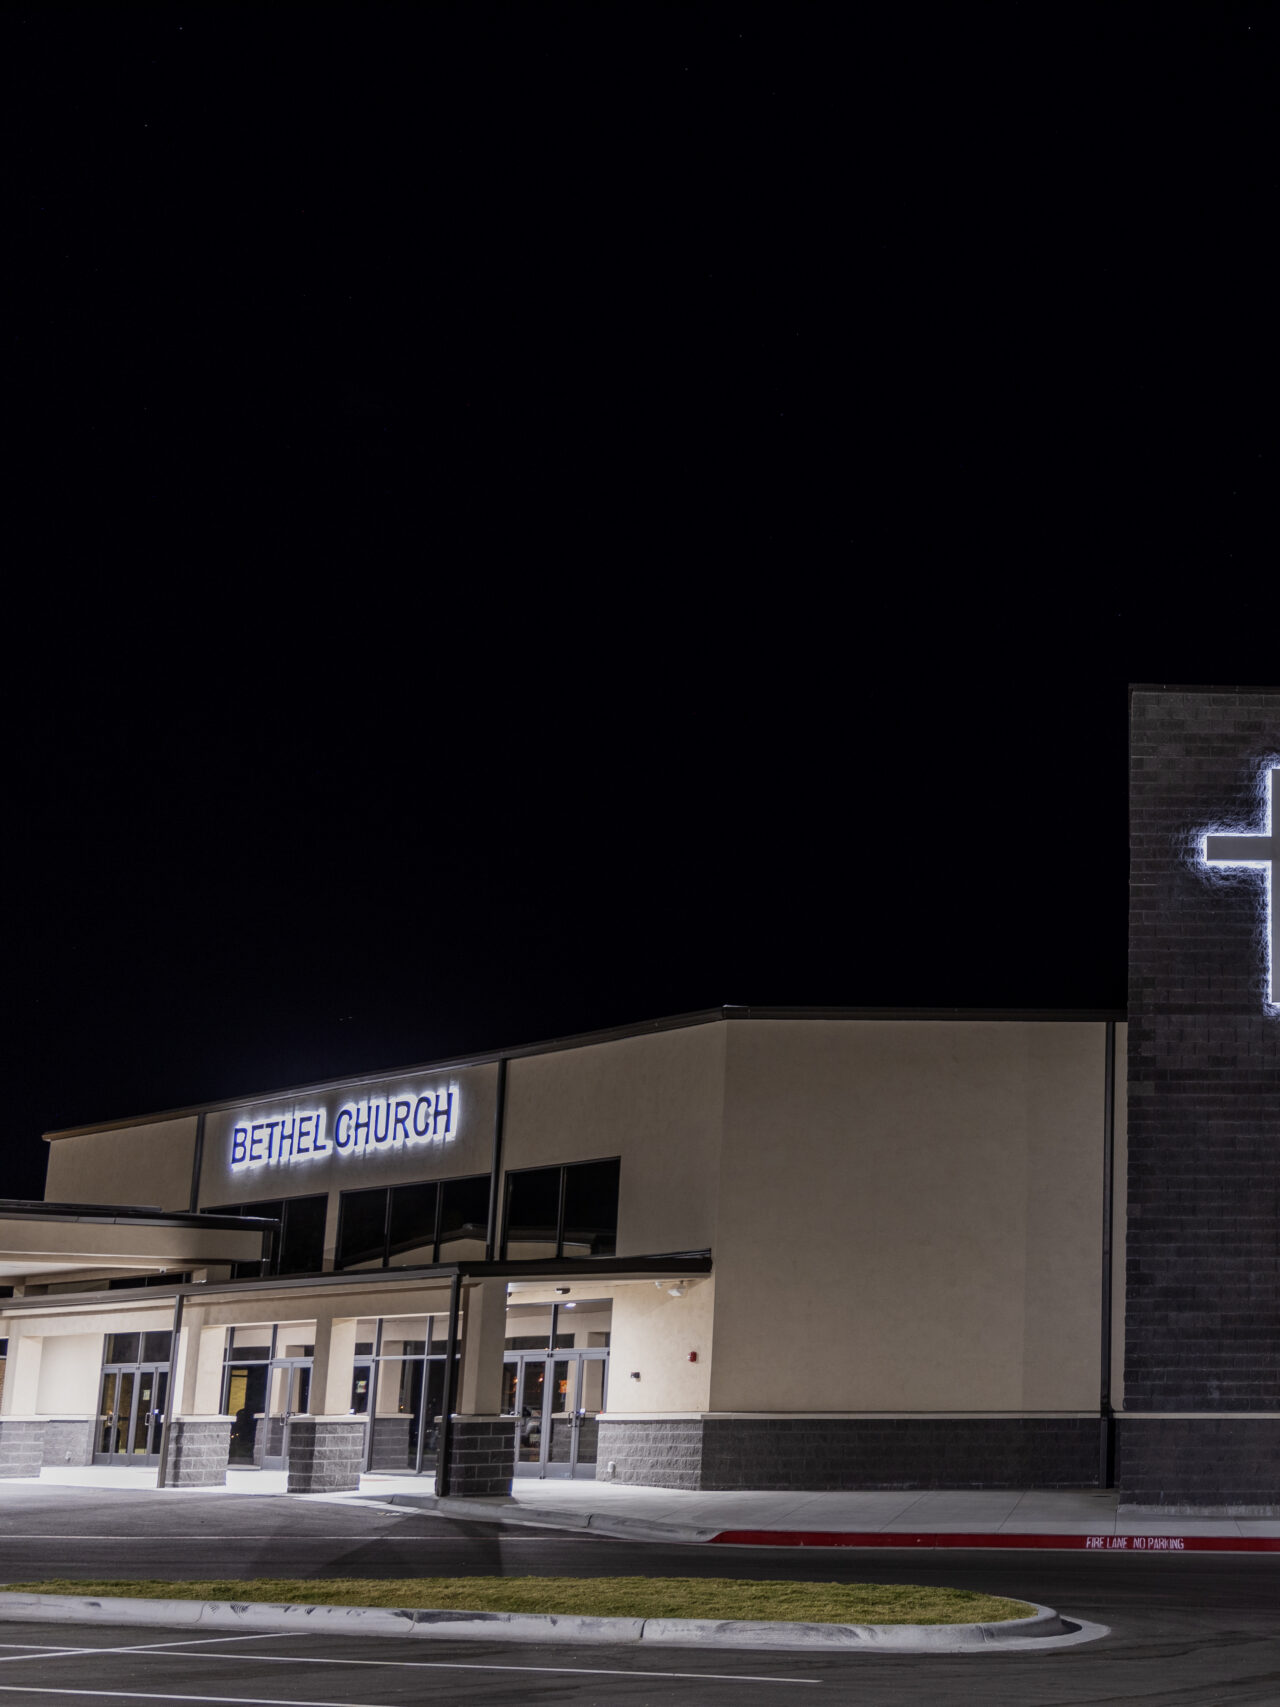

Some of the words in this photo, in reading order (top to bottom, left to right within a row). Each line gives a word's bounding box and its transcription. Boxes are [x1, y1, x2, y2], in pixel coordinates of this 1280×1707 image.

[232, 1114, 327, 1164] BETHEL
[335, 1092, 454, 1148] CHURCH
[1086, 1536, 1104, 1549] FIRE
[1107, 1537, 1128, 1549] LANE
[1133, 1537, 1145, 1549] NO
[1148, 1537, 1184, 1550] PARKING
